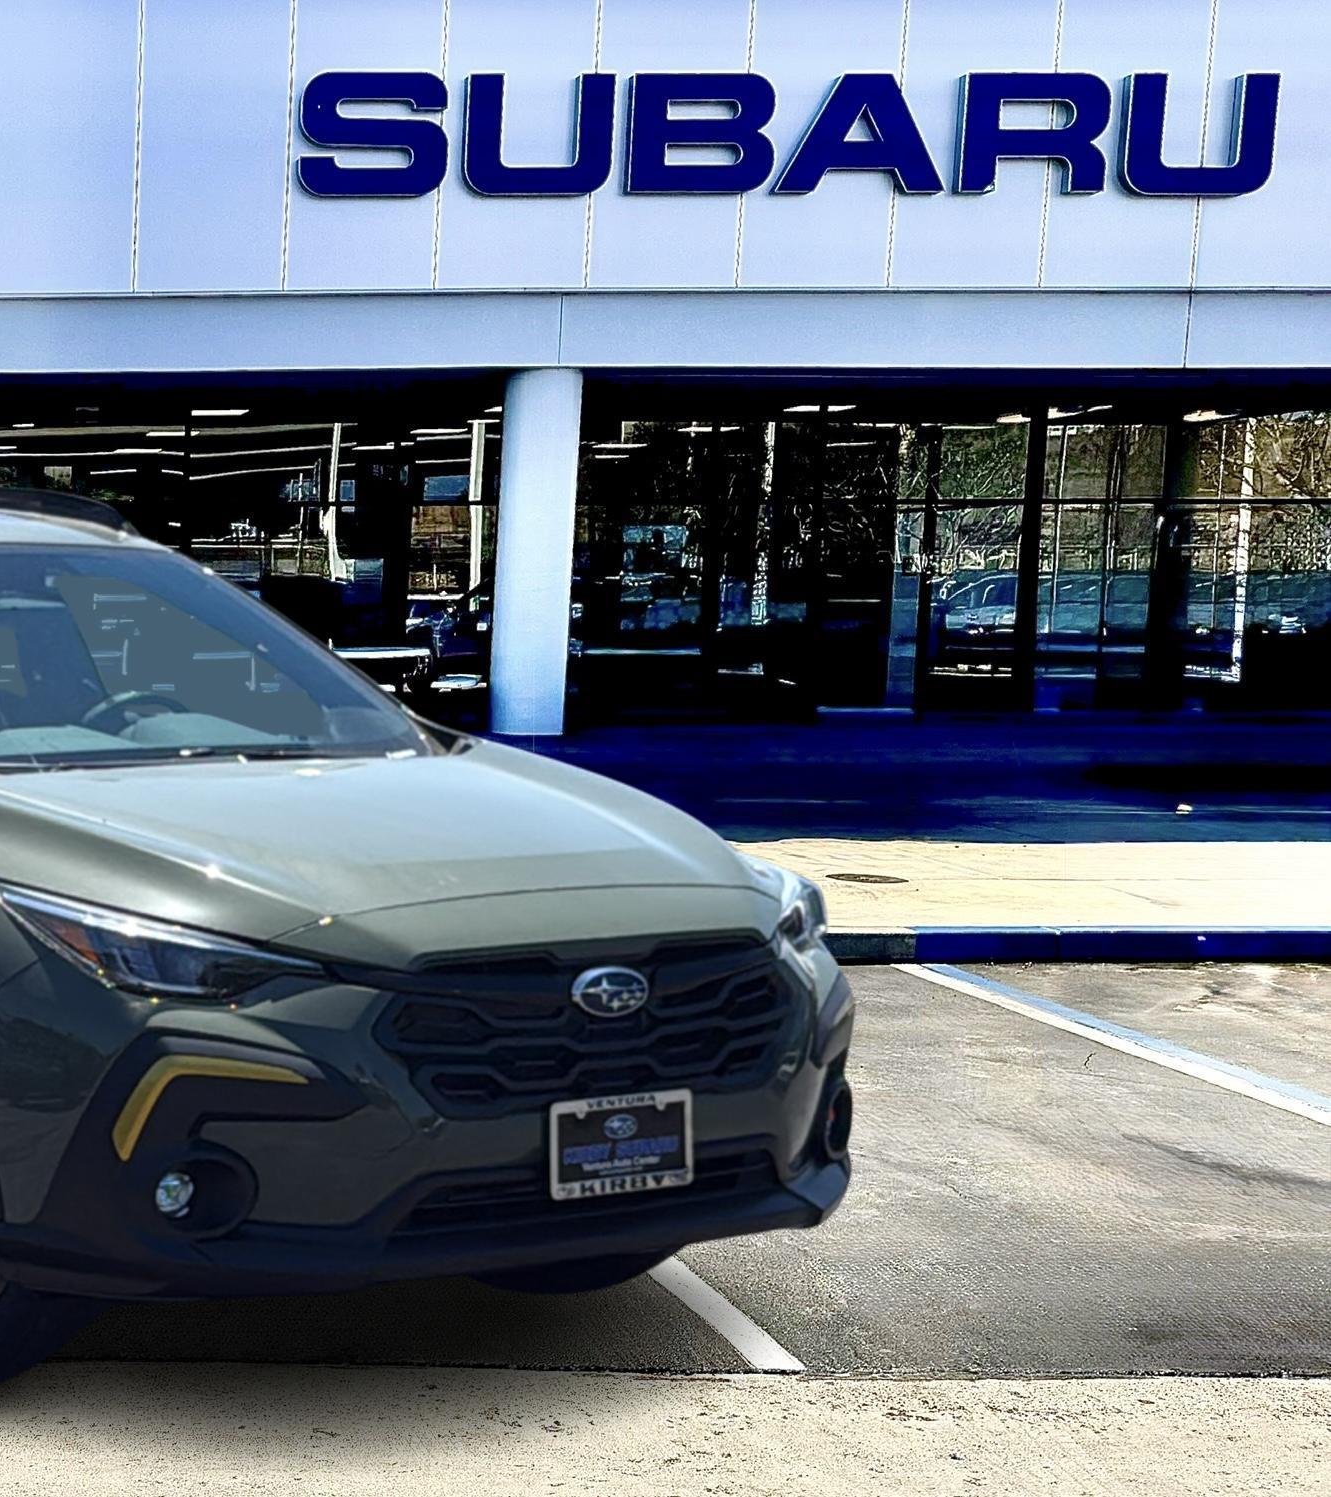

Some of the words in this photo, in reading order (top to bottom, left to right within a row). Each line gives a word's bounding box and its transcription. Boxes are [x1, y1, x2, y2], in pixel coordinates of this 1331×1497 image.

[296, 71, 1280, 199] SUBARU
[586, 1094, 657, 1110] VENTURA
[579, 1174, 665, 1196] KIRBY
